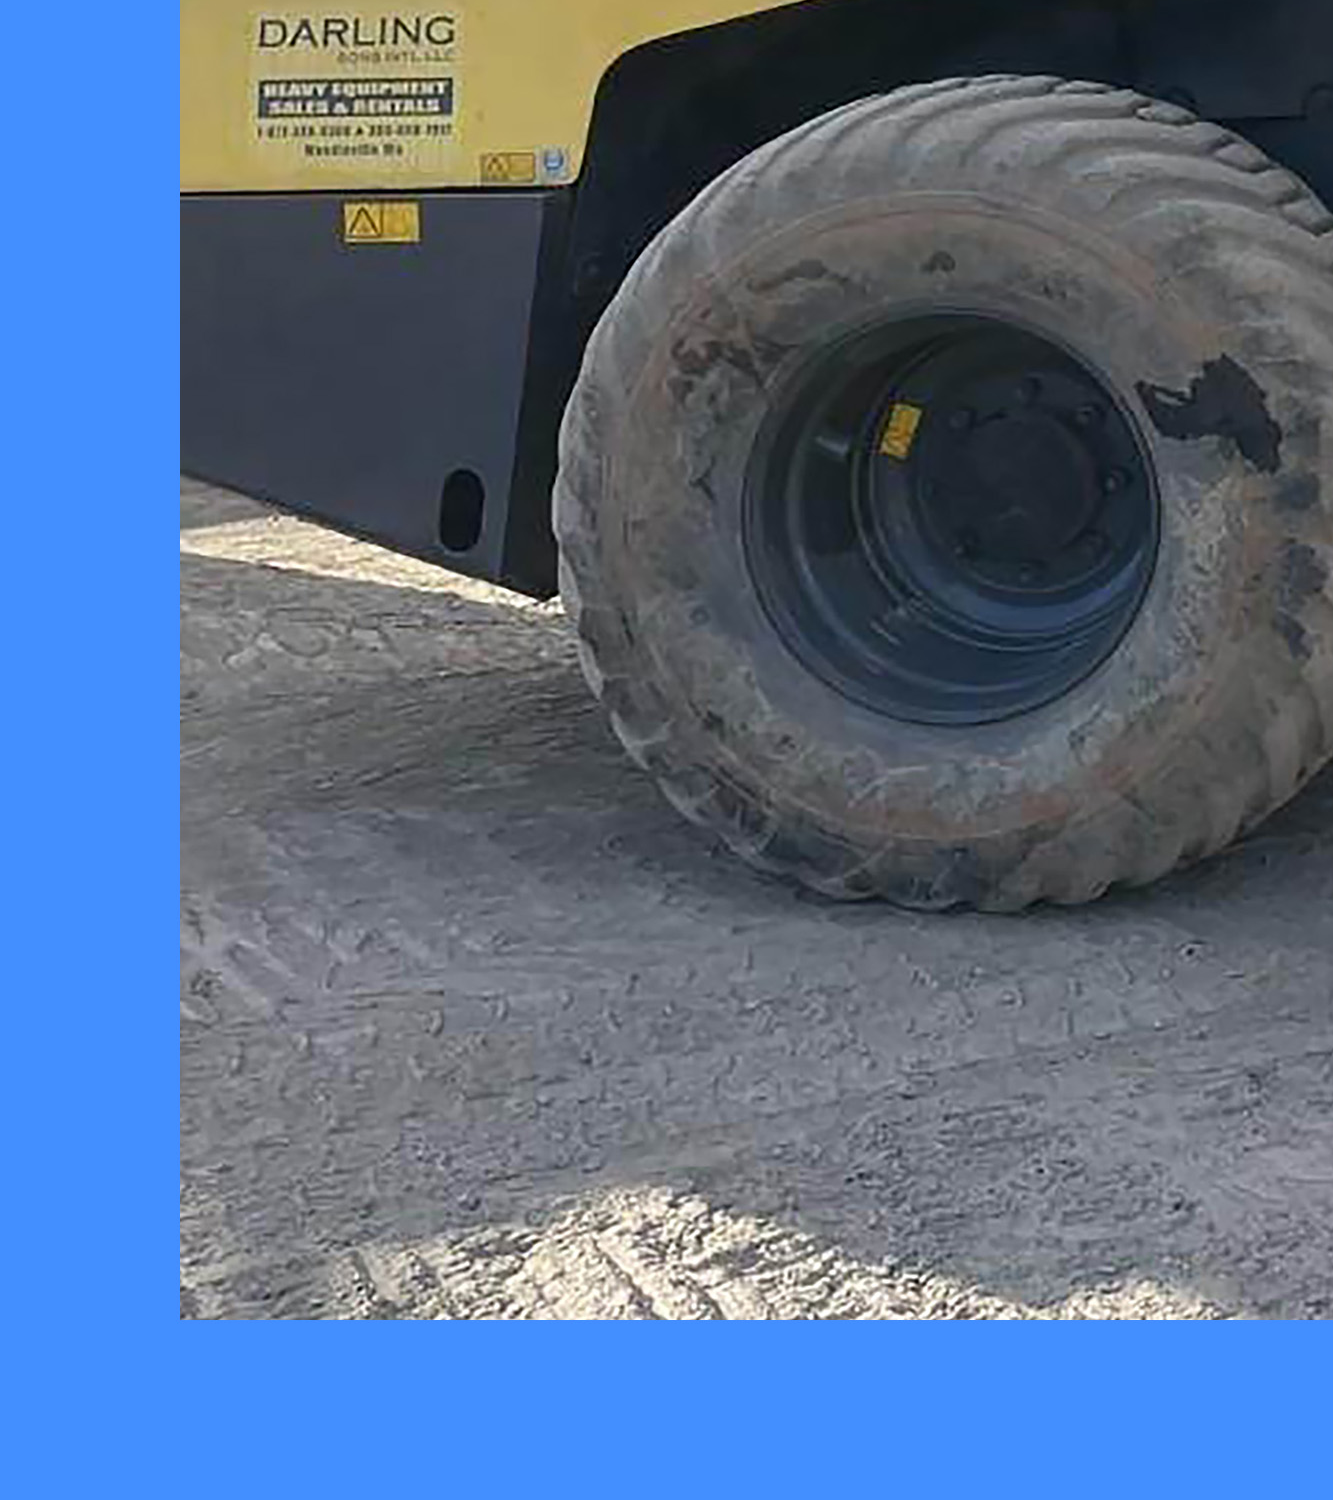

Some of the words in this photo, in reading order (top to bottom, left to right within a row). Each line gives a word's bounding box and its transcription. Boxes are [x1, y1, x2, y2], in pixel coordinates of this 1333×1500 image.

[258, 16, 456, 48] DARLING
[262, 83, 329, 98] HEAVY
[331, 81, 447, 97] EQUIPMENT
